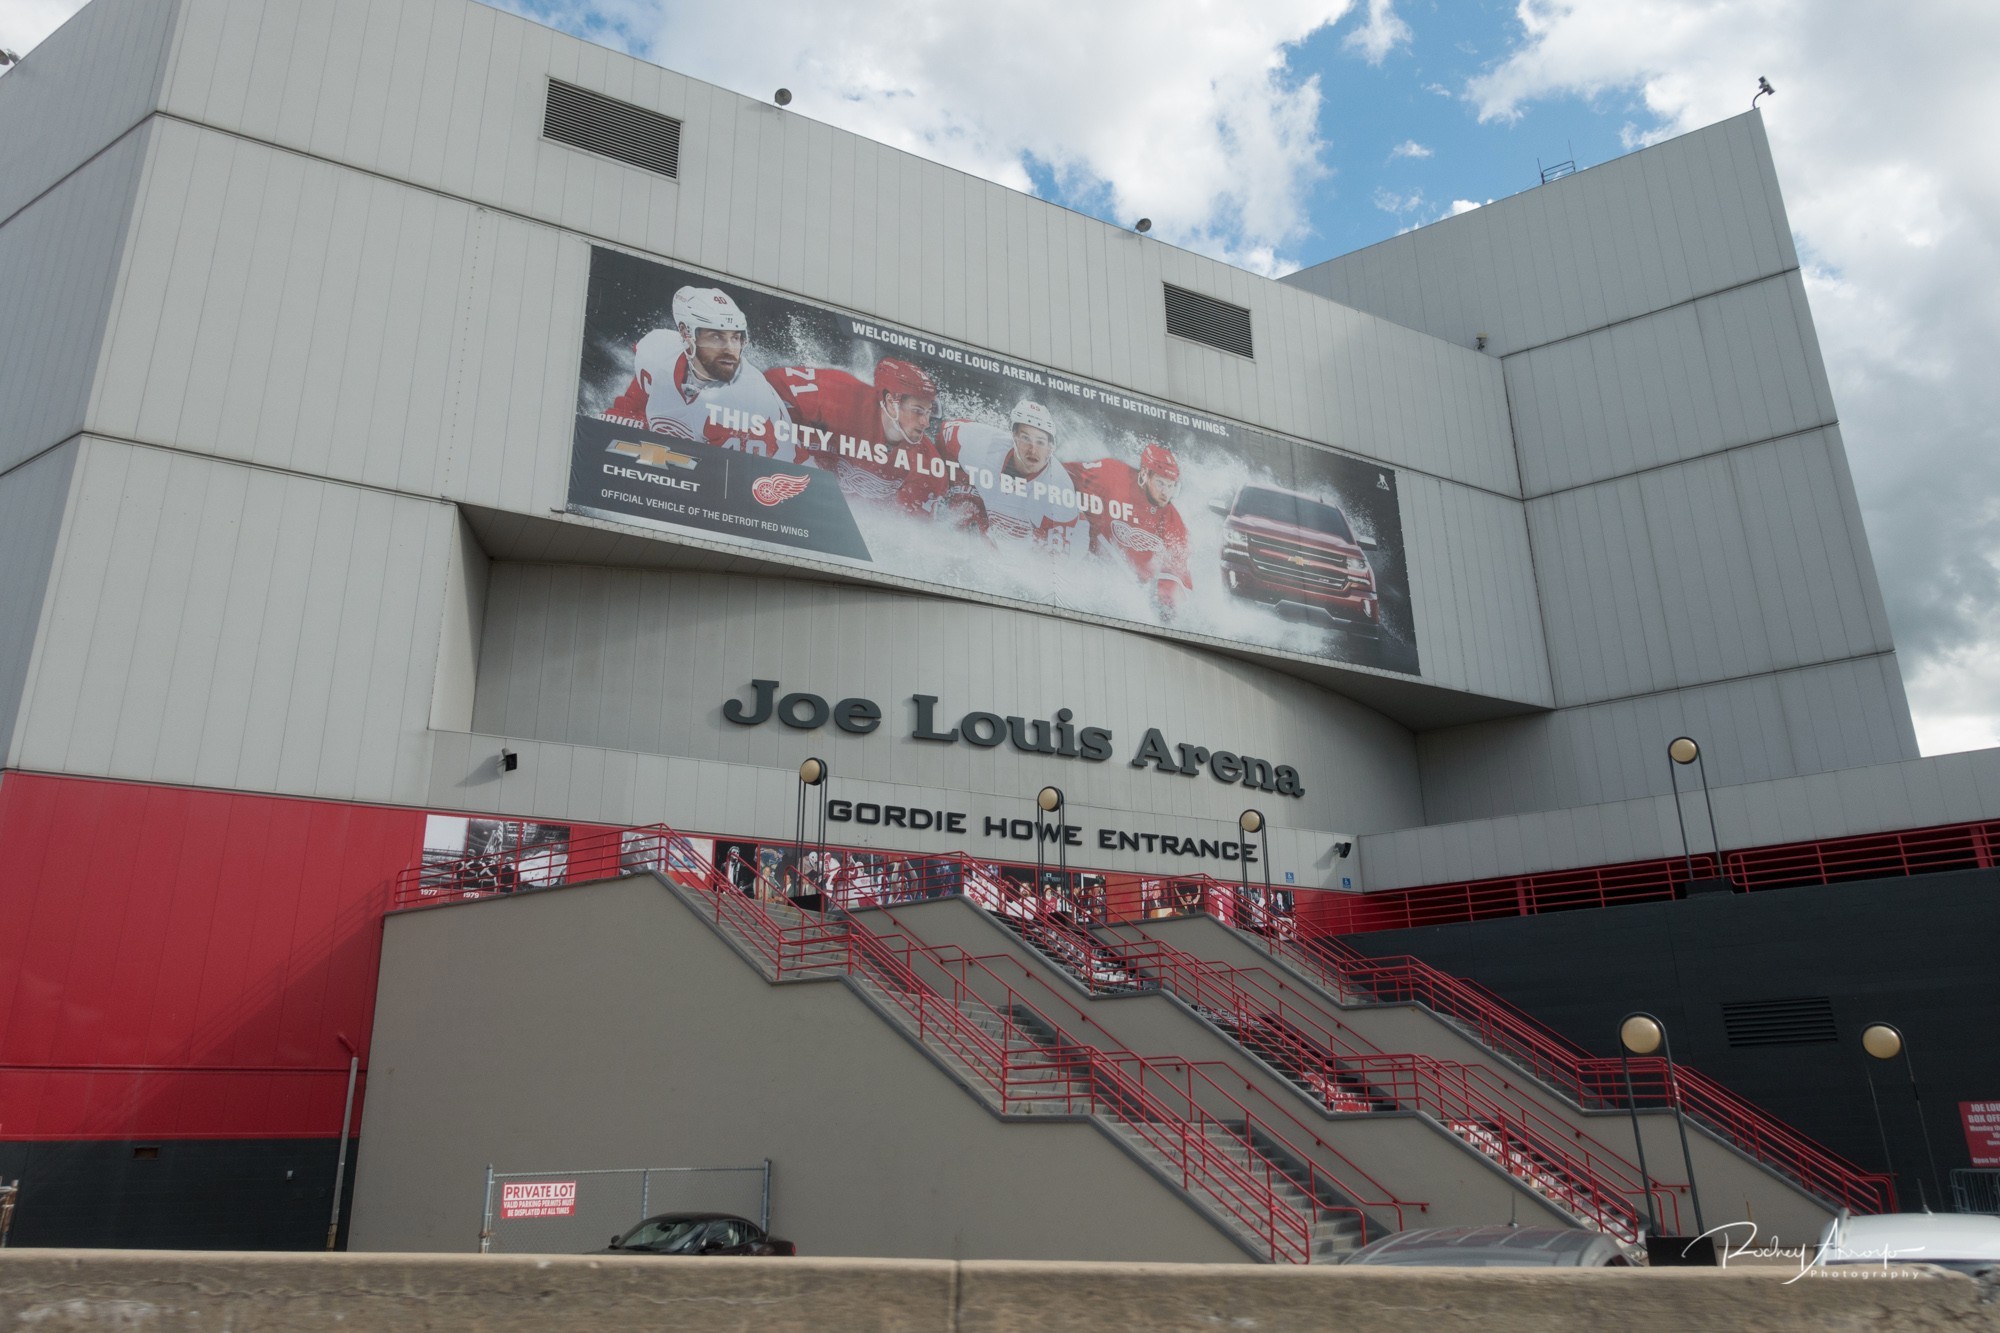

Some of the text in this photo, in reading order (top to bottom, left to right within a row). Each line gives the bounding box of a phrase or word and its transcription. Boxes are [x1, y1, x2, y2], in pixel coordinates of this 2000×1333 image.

[852, 321, 1230, 437] WELCOME TO JOE LOUIS ARENA. HOME OF THE DETROIT RED WINGS.
[705, 403, 1140, 524] THIS CITY HAS A LOT TO BE PROUD OF.
[603, 464, 701, 492] CHEVROLET
[601, 488, 809, 538] OFFICIAL VEHICLE OF THE DETROIT RED WINGS
[723, 678, 1306, 798] Joe Louis Arena
[827, 798, 1259, 863] GORDIE HOWE ENTRANCE
[420, 888, 438, 896] 1977
[1971, 1103, 1985, 1112] JOE
[1967, 1114, 1986, 1123] BOX
[505, 1184, 574, 1199] PRIVATE LOT
[504, 1198, 575, 1209] VALID PARKING PERMITS MUST
[508, 1209, 514, 1217] BE
[514, 1208, 541, 1216] DISPLAYED
[547, 1207, 556, 1215] ALL
[556, 1206, 570, 1215] TIMES
